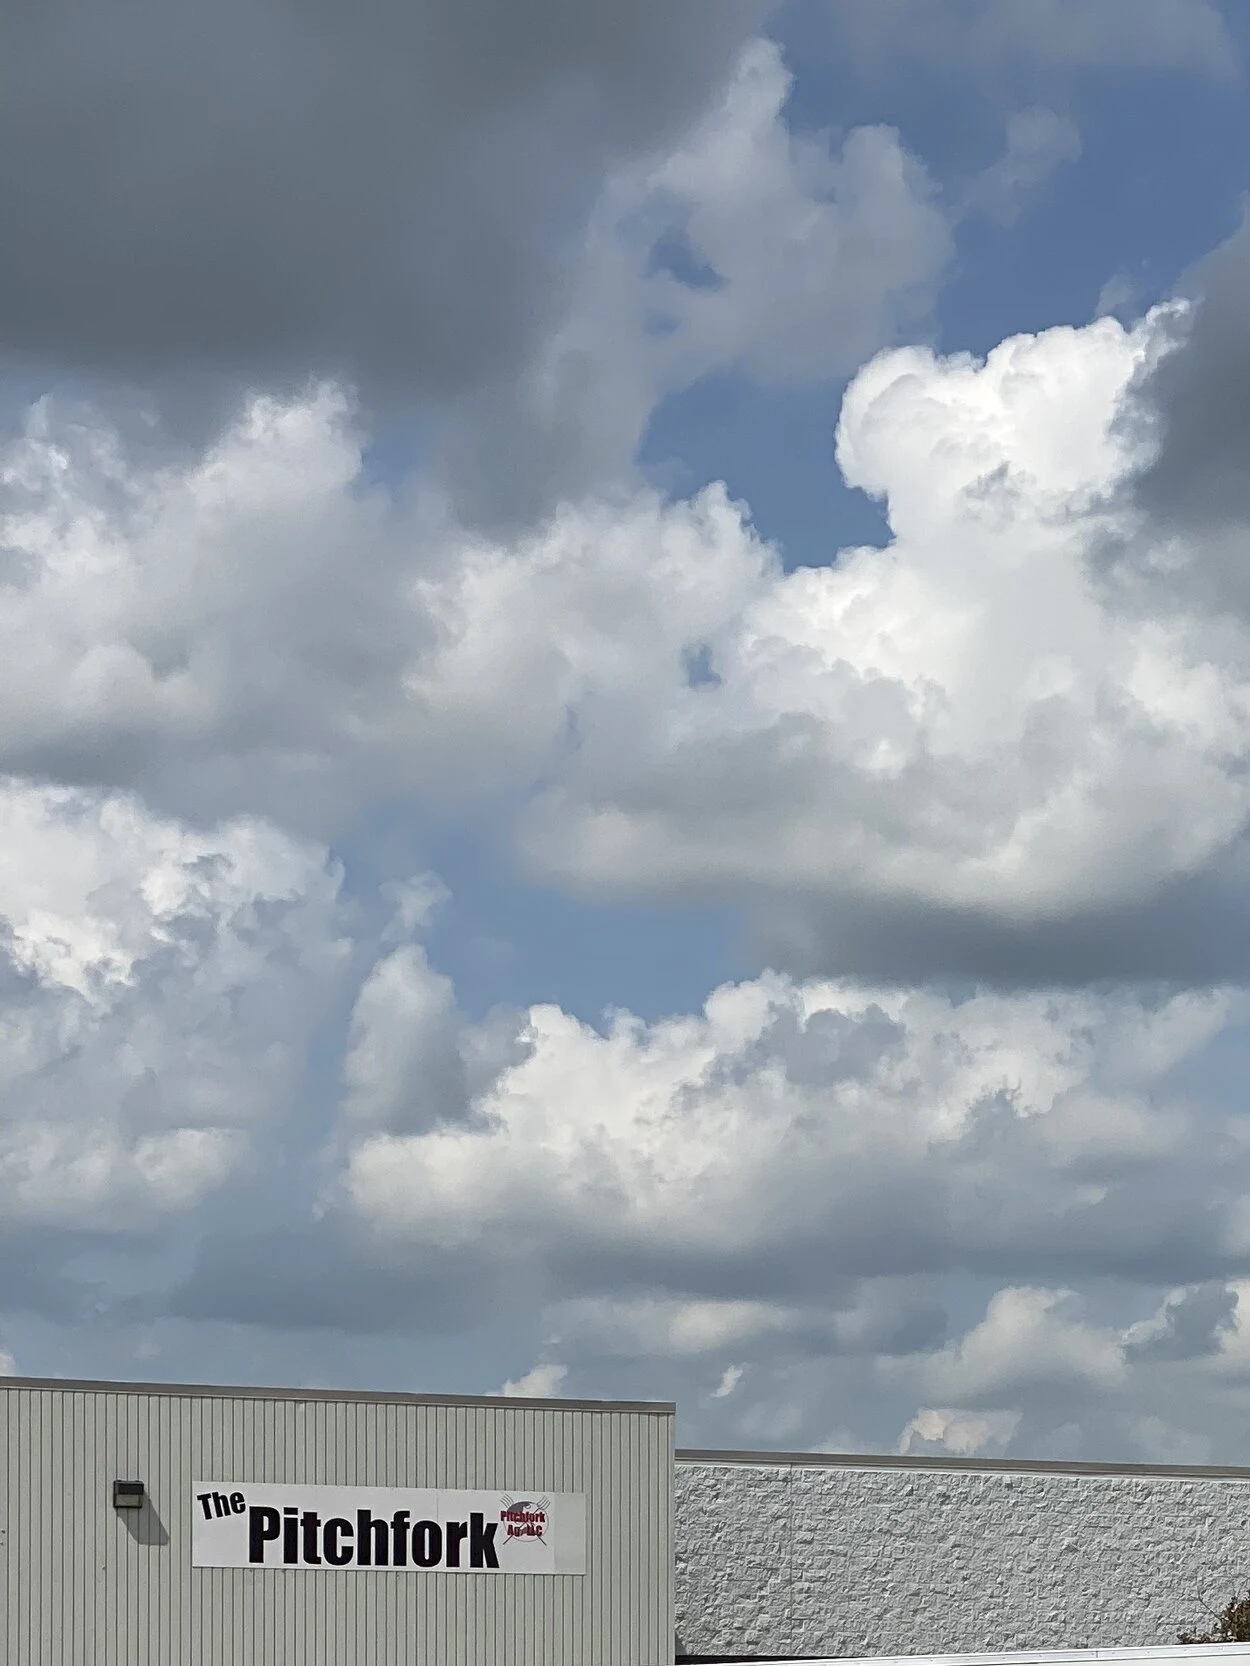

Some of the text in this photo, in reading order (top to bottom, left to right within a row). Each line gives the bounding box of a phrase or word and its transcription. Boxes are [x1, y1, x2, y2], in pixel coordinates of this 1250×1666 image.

[197, 1491, 500, 1569] The Pitchfork
[500, 1510, 546, 1523] Pitchfork
